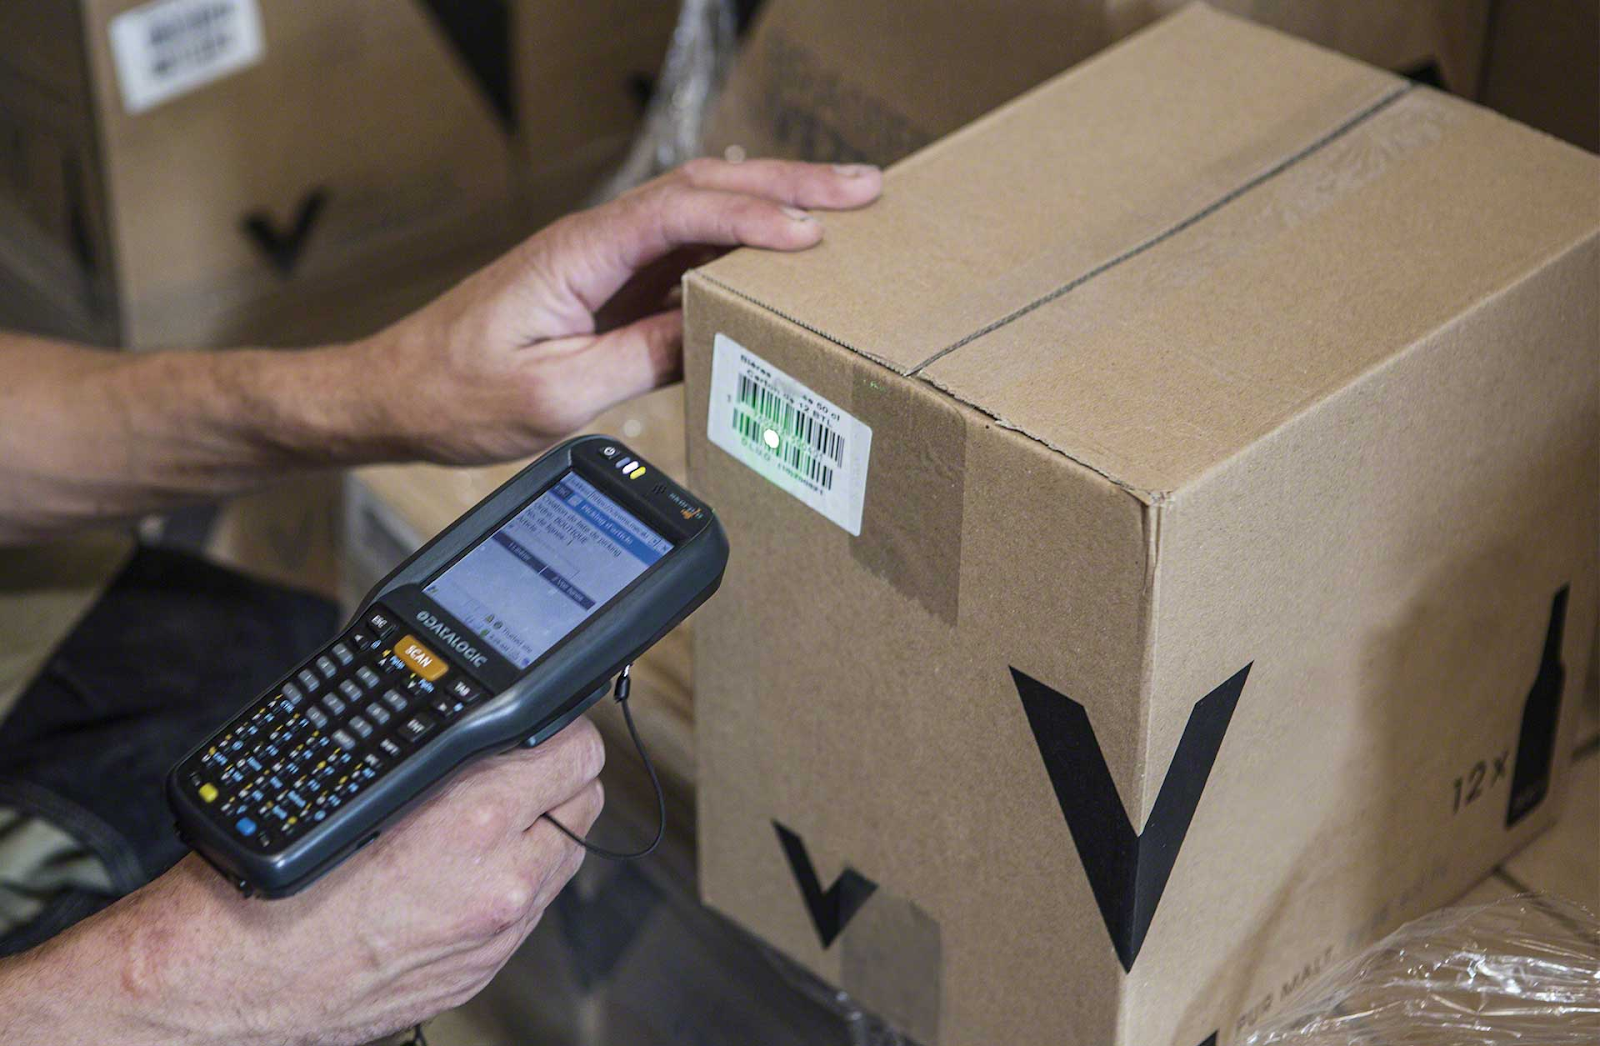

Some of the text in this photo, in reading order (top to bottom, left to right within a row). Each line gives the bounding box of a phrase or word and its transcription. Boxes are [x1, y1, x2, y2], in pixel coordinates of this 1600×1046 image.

[369, 614, 388, 628] ESC
[422, 616, 488, 668] DATALOGIC
[402, 644, 434, 668] SCAN
